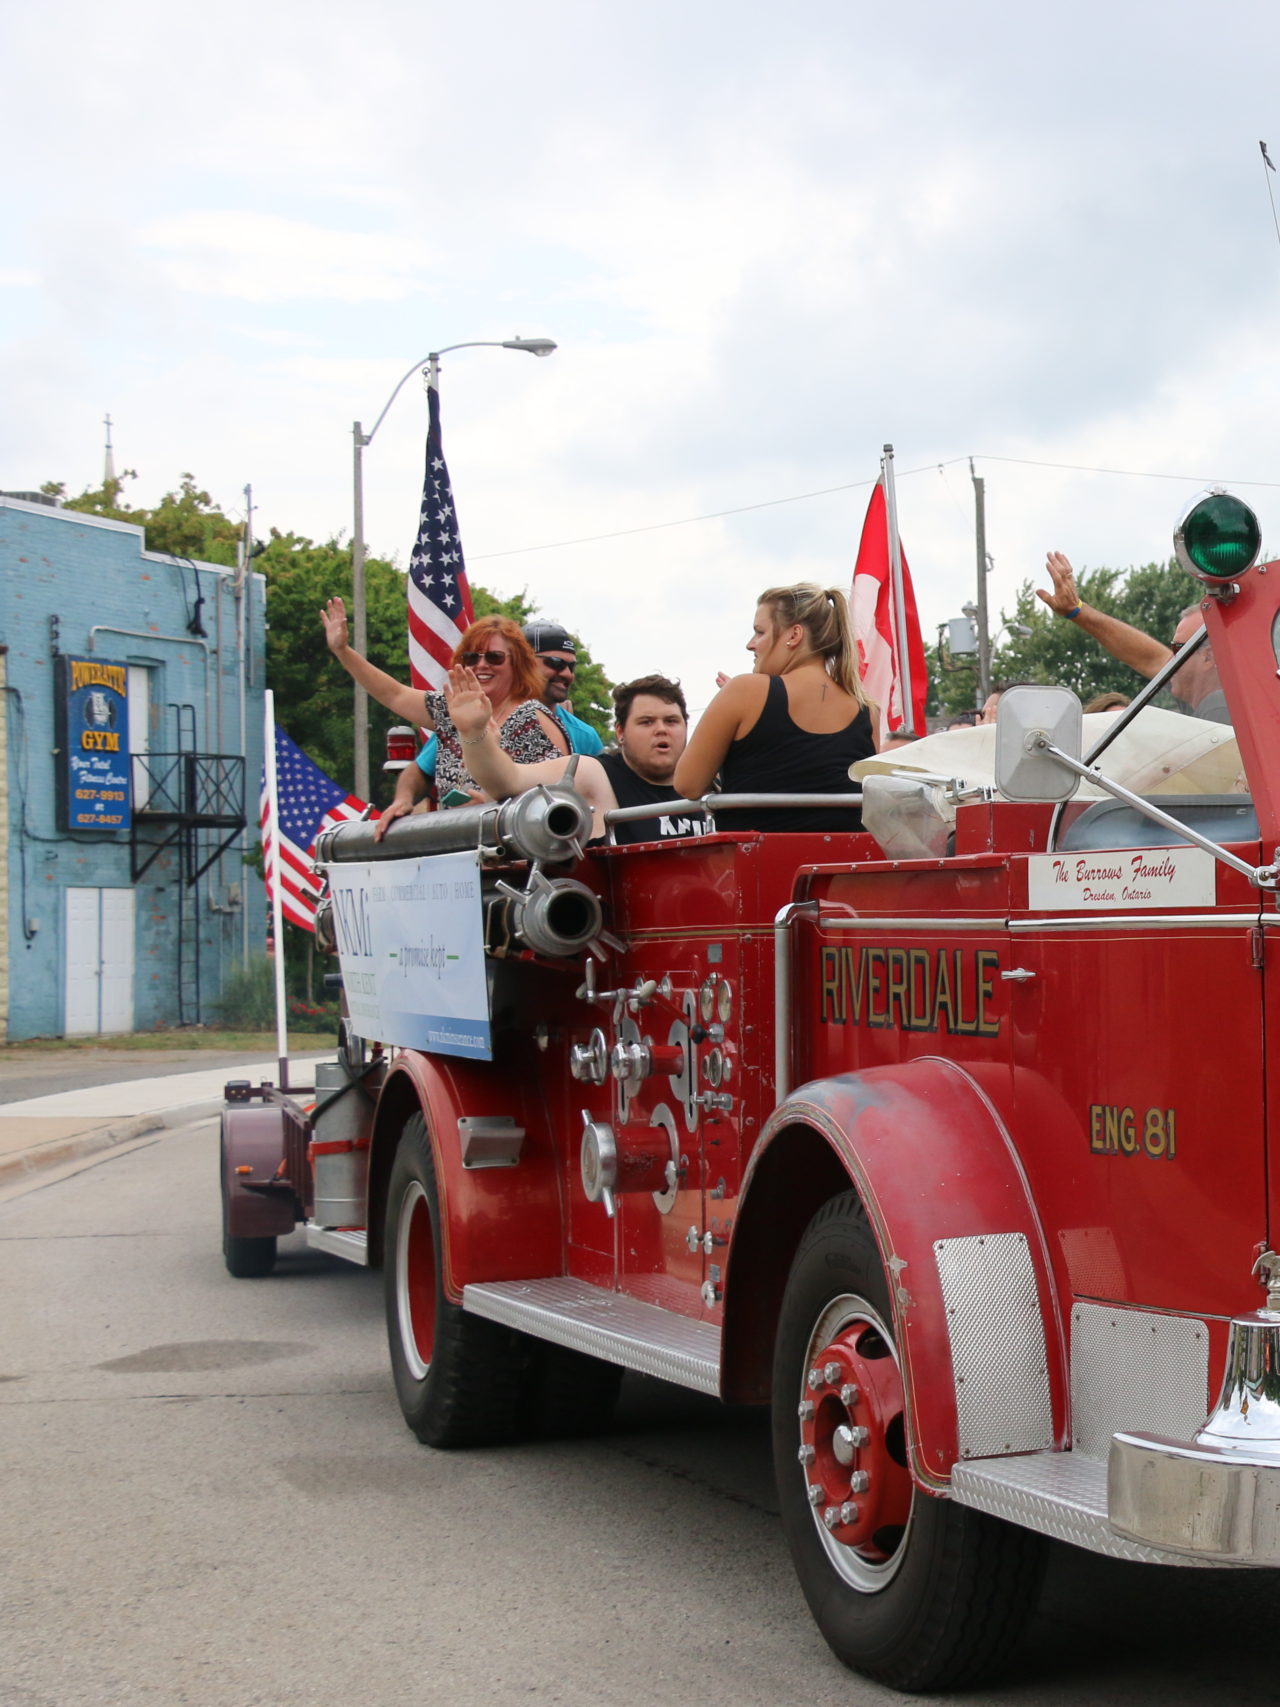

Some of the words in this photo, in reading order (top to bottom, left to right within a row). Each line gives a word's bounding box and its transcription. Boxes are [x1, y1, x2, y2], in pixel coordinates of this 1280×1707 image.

[82, 731, 120, 752] GYM
[1053, 860, 1070, 883] The
[1076, 859, 1123, 882] Burrows
[1130, 855, 1176, 883] Family
[1083, 887, 1117, 902] Dresden,
[1121, 886, 1152, 901] Ontario
[820, 946, 1000, 1038] RIVERDALE
[1145, 1107, 1176, 1160] 81
